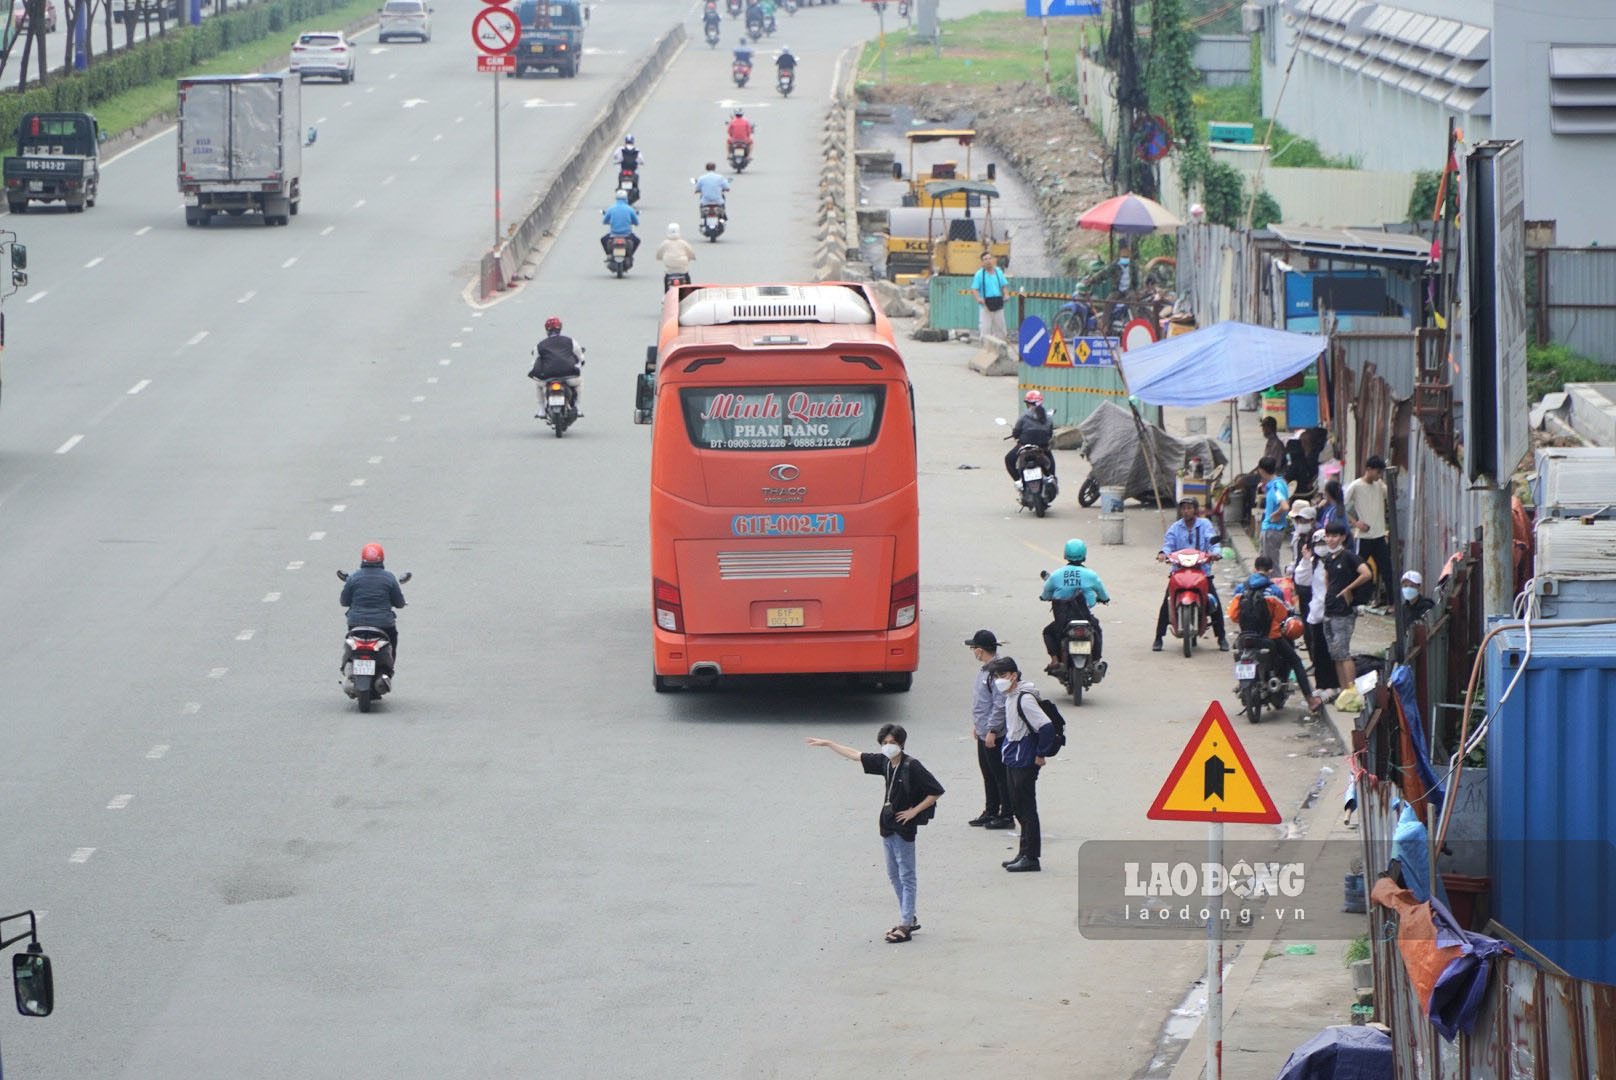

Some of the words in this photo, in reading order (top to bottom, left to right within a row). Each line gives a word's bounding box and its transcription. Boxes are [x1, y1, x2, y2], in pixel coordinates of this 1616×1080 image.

[701, 393, 782, 419] Minh
[788, 392, 863, 423] Quân
[735, 425, 779, 437] PHAN
[783, 424, 829, 436] RANG
[762, 487, 806, 495] THACO
[735, 514, 840, 535] 61F-002.71
[1063, 570, 1081, 578] BAE
